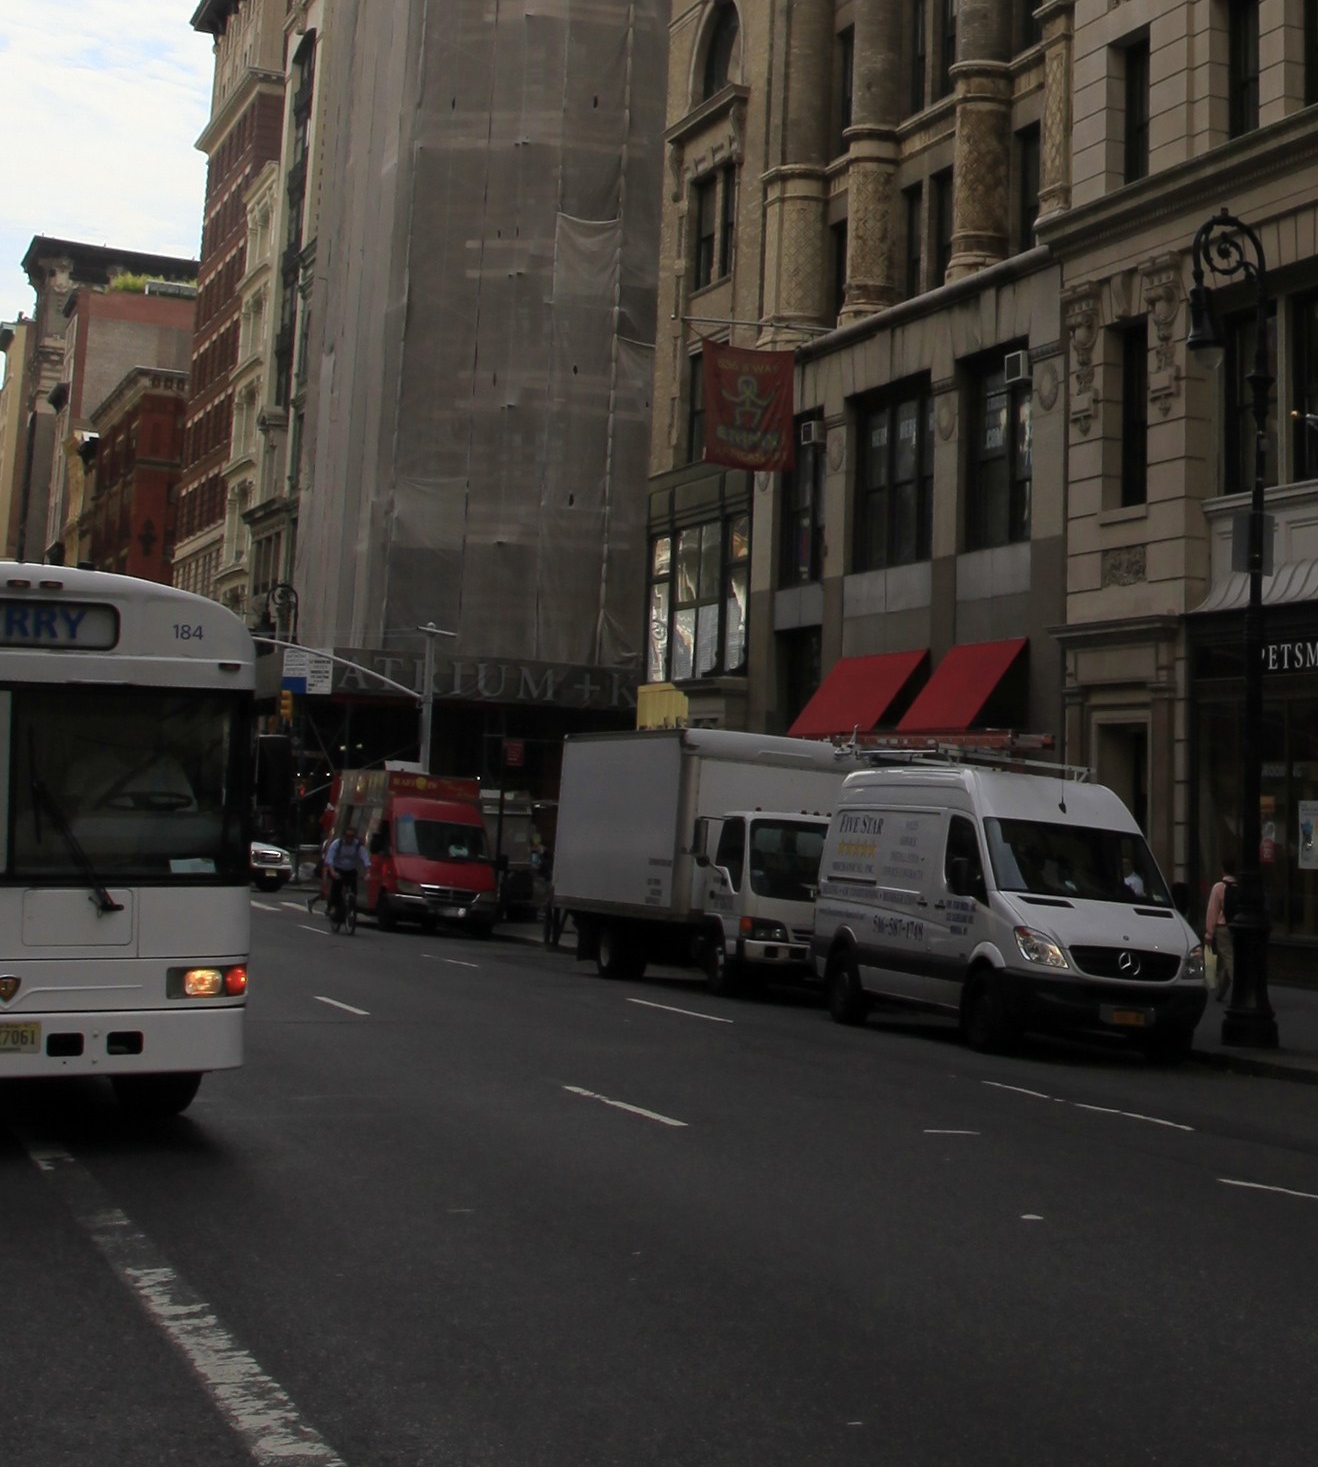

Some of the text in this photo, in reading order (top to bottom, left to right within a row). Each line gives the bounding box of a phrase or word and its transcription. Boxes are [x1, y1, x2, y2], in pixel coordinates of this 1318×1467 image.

[172, 624, 205, 641] 184
[336, 654, 559, 702] ATRIUM
[840, 814, 861, 834] FIVE
[861, 815, 885, 835] STAR
[0, 1029, 36, 1046] 7061
